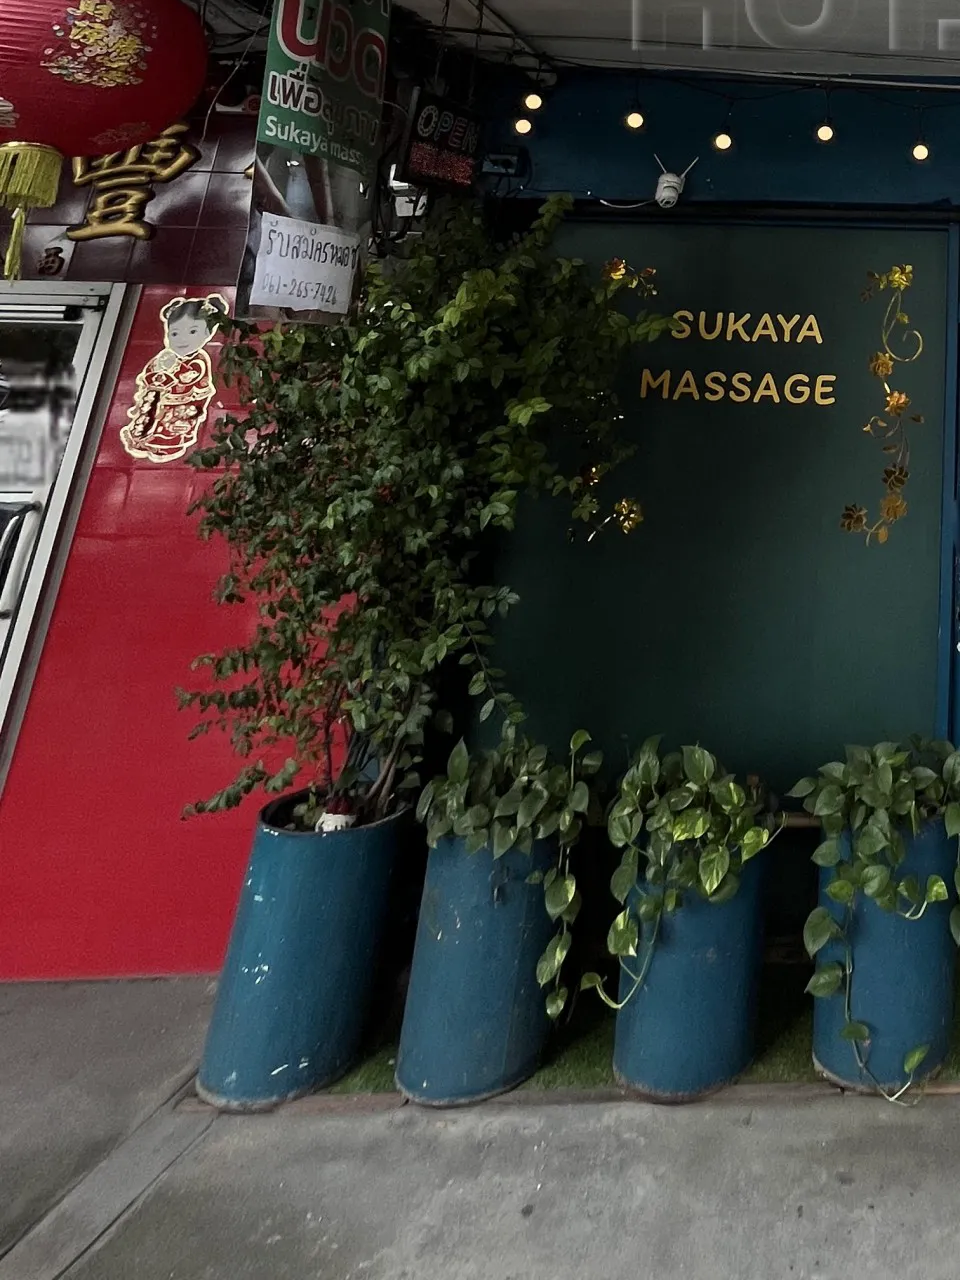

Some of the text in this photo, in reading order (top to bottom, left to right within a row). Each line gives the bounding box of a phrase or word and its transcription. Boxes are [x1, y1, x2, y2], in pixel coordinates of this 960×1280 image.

[264, 115, 329, 153] Sukaya
[417, 105, 480, 154] OPEN
[671, 310, 823, 344] SUKAYA
[640, 368, 837, 406] MASSAGE
